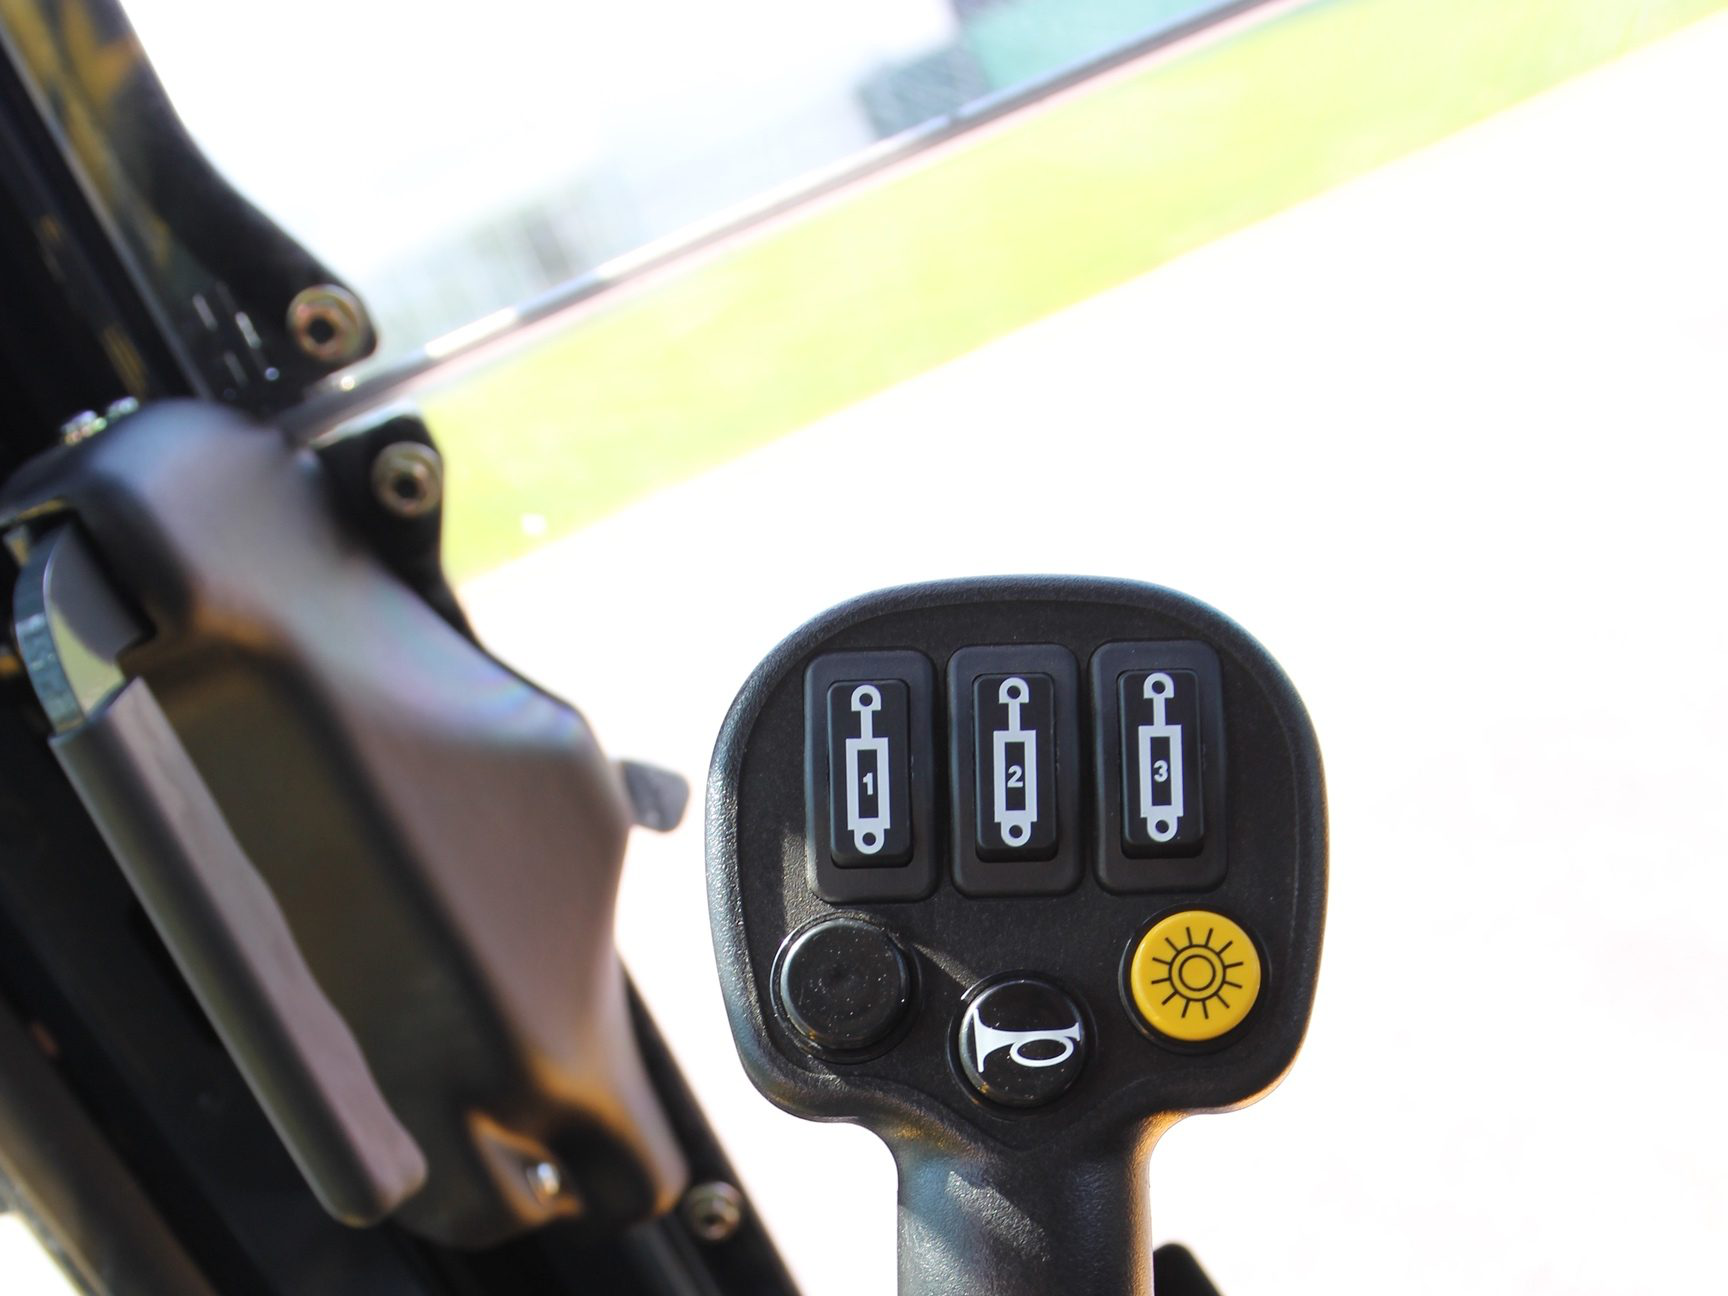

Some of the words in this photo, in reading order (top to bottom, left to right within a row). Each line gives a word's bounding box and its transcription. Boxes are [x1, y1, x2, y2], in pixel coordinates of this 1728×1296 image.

[1006, 765, 1024, 788] 2
[1153, 760, 1169, 783] 3
[862, 772, 874, 796] 1
